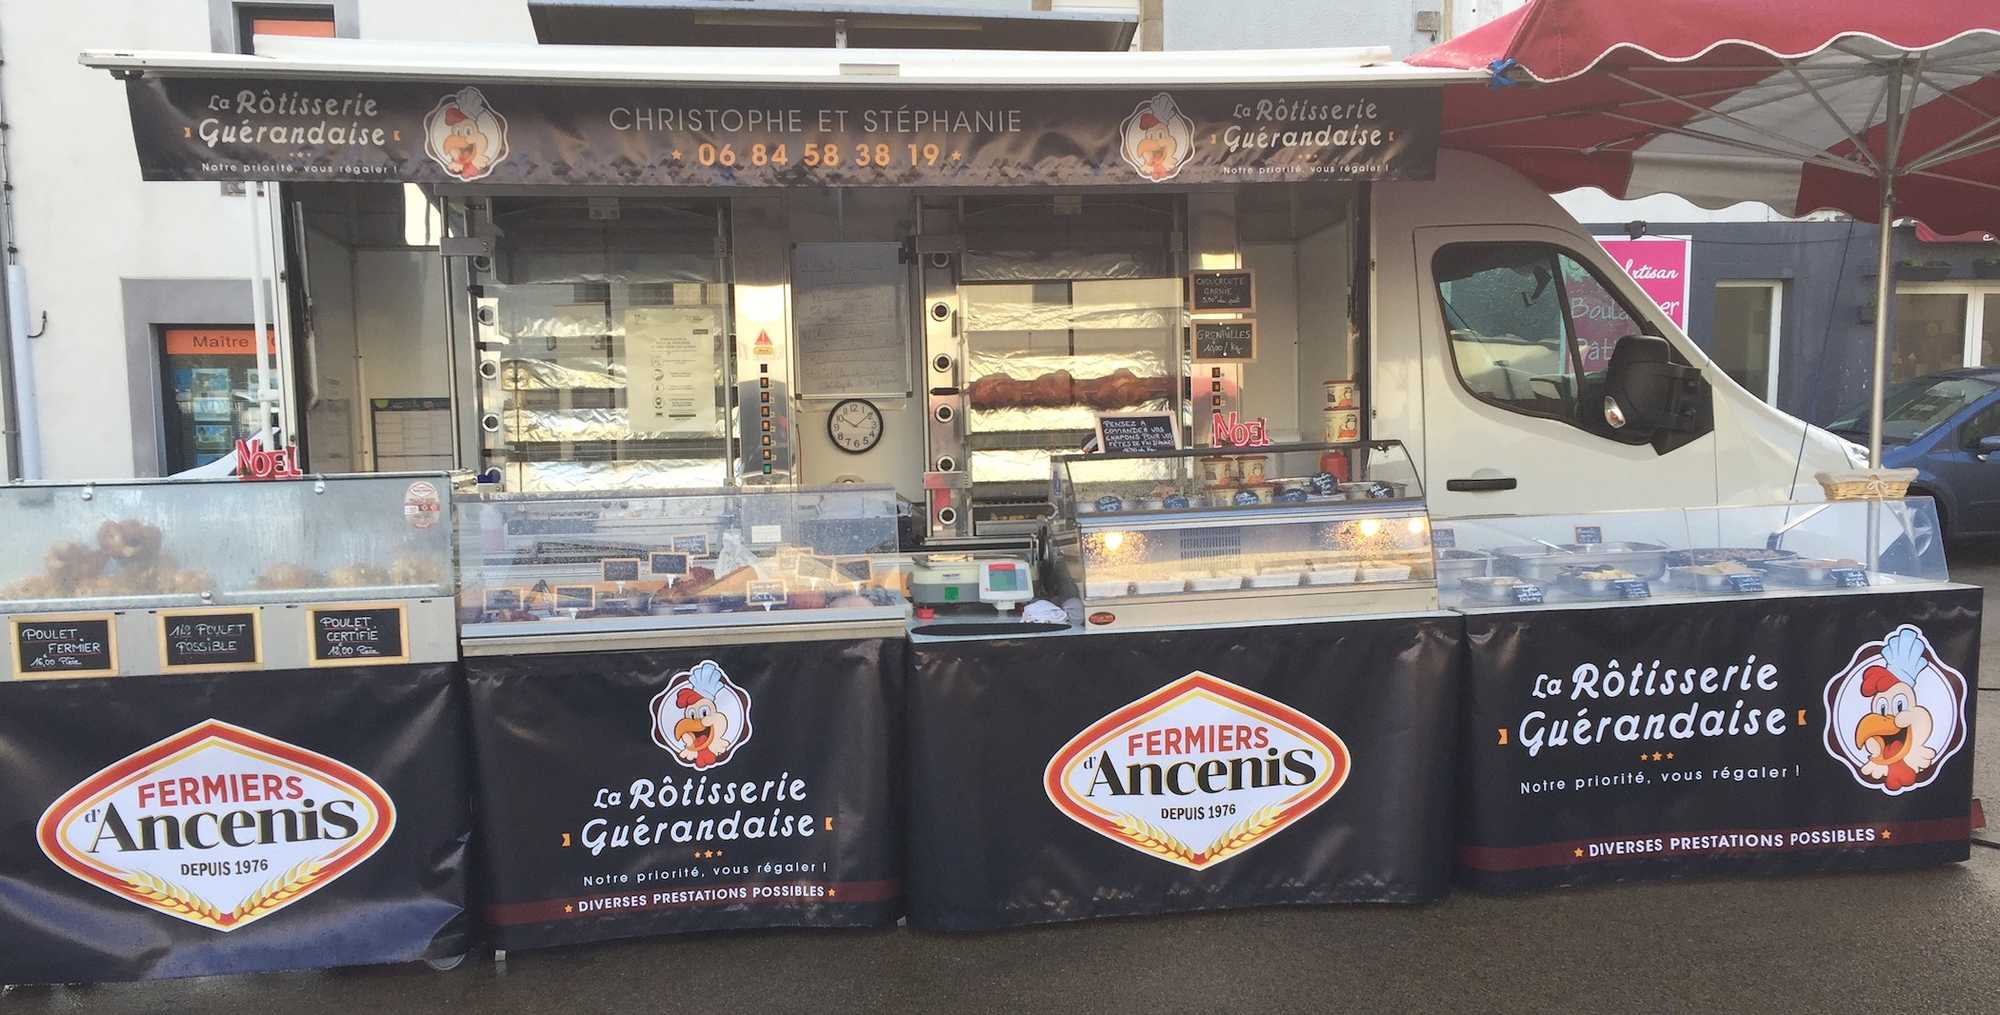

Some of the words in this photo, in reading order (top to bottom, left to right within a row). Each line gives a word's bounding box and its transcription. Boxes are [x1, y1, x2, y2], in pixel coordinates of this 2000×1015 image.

[208, 95, 230, 111] La
[236, 89, 377, 116] Rôtisserie
[1233, 103, 1250, 119] La
[1256, 97, 1377, 121] Rôtisserie
[609, 107, 802, 132] CHRISTOPHE
[818, 109, 848, 132] ET
[863, 105, 1021, 132] STÉPHANIE
[199, 118, 385, 148] Guérandaise
[1223, 124, 1382, 152] Guérandaise
[698, 143, 736, 166] 06
[751, 143, 788, 166] 84
[804, 143, 840, 166] 58
[856, 143, 890, 166] 38
[907, 143, 939, 166] 19
[202, 162, 237, 172] Notre
[303, 164, 333, 173] vous
[339, 163, 388, 175] régaler
[1223, 166, 1253, 175] Notre
[1310, 165, 1335, 173] vous
[1340, 163, 1381, 175] régaler
[192, 335, 249, 348] Maître
[22, 628, 77, 640] POULET
[196, 623, 246, 636] POULET
[320, 616, 371, 628] POULET
[48, 638, 100, 654] FERMIER
[175, 638, 237, 655] POSSIBLE
[1532, 673, 1562, 699] La
[1570, 654, 1778, 700] Rôtisserie
[1127, 724, 1269, 757] FERMIERS
[1518, 699, 1786, 757] Guérandaise
[138, 773, 304, 809] FERMIERS
[593, 787, 622, 809] La
[629, 771, 807, 810] Rôtisserie
[1520, 778, 1566, 794] Notre
[1575, 771, 1651, 791] priorité,
[1661, 770, 1703, 783] vous
[1712, 766, 1788, 782] régaler
[1161, 806, 1205, 821] DEPUIS
[1208, 804, 1236, 819] 1976
[581, 808, 815, 856] Guérandaise
[1589, 838, 1663, 857] DIVERSES
[1670, 833, 1784, 851] PRESTATIONS
[1790, 828, 1875, 846] POSSIBLES
[180, 860, 231, 877] DEPUIS
[234, 858, 268, 876] 1976
[583, 873, 629, 887] Notre
[637, 865, 705, 884] priorité,
[713, 864, 749, 875] vous
[757, 862, 817, 876] régaler
[578, 895, 647, 912] DIVERSES
[653, 887, 747, 905] PRESTATIONS
[752, 886, 825, 899] POSSIBLES
